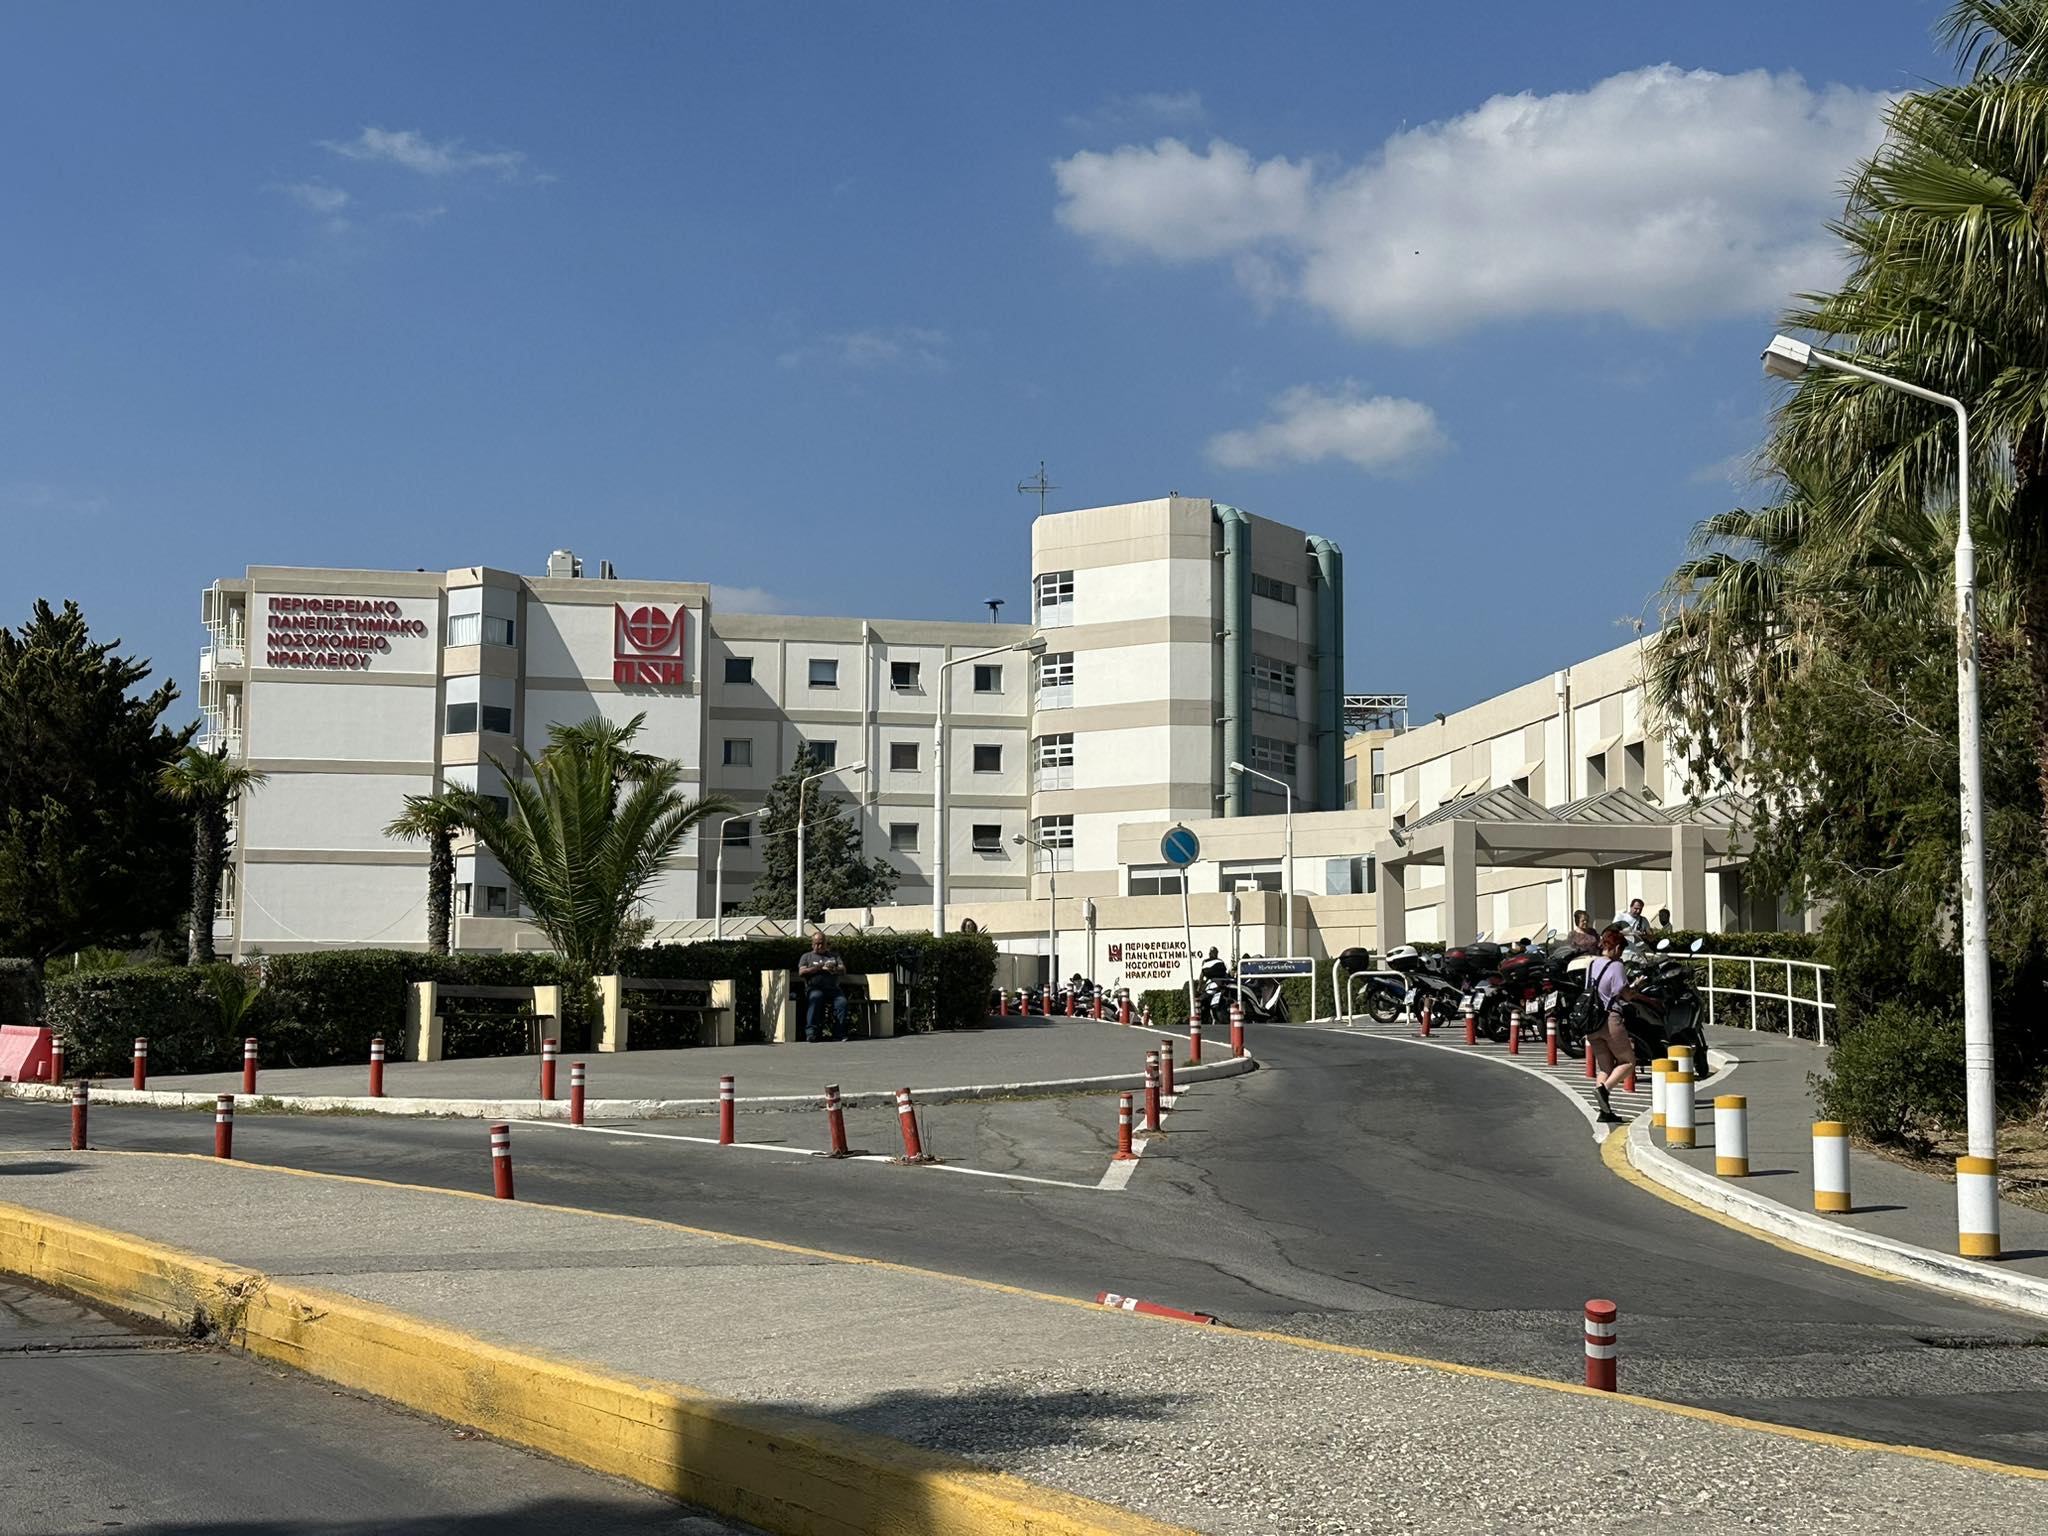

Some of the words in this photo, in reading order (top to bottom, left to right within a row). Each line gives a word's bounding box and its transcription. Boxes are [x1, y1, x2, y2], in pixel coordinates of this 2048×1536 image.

[268, 597, 398, 613] ΠΕΡΙΦΕΡΕΙΑΚΟ
[268, 615, 424, 633] ΠΑΝΕΠΙΣΤΗΜΙΑΚΟ
[267, 633, 387, 649] ΝΟΣΟΚΟΜΕΙΟ
[267, 651, 372, 668] ΗΡΑΚΛΕΙΟΥ
[1125, 941, 1187, 951] ΠΕΡΙΦΕΡΕΙΑΚΟ
[1125, 960, 1181, 970] ΝΟΣΟΚΟΜΕΙΟ
[1125, 970, 1171, 979] ΗΡΑΚΛΕΙΟΥ
